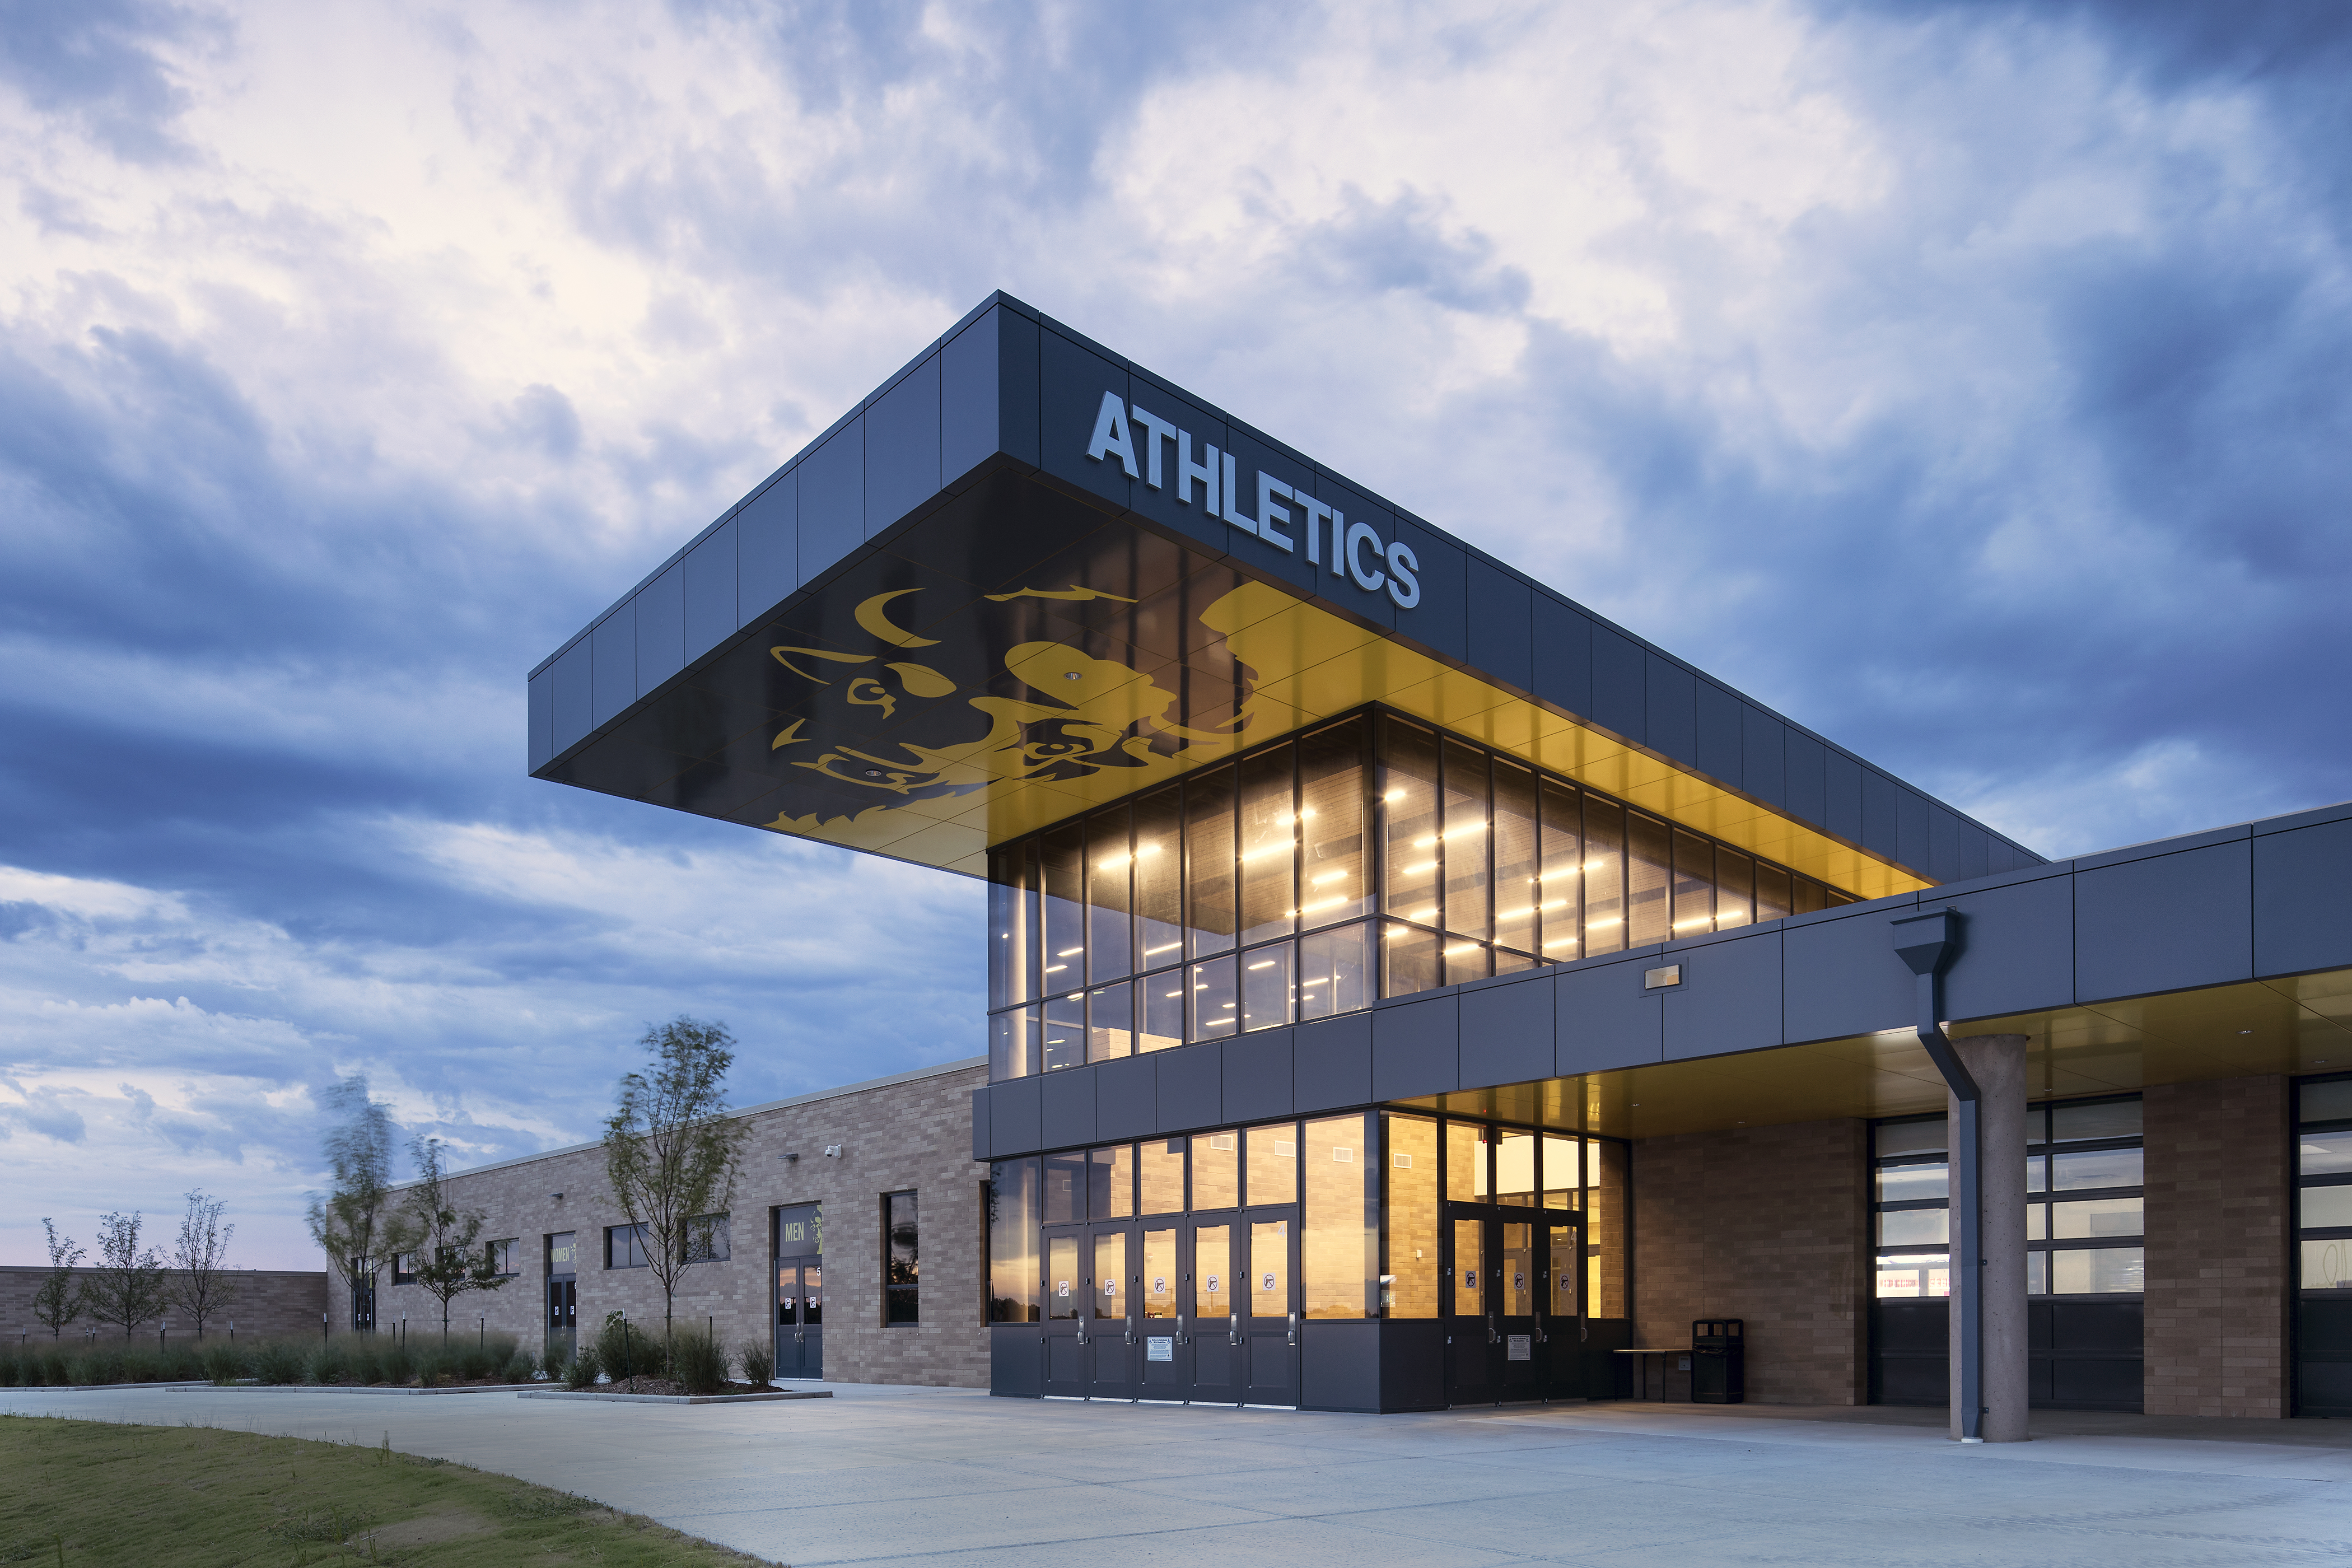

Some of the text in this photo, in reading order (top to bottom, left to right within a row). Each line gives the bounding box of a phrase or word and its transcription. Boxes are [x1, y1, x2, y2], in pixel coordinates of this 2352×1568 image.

[1085, 390, 1420, 609] ATHLETICS
[785, 1222, 804, 1242] MEN
[1277, 1224, 1286, 1237] 4
[1570, 1230, 1576, 1243] 4
[550, 1247, 570, 1263] WOMEN
[816, 1267, 821, 1276] 5
